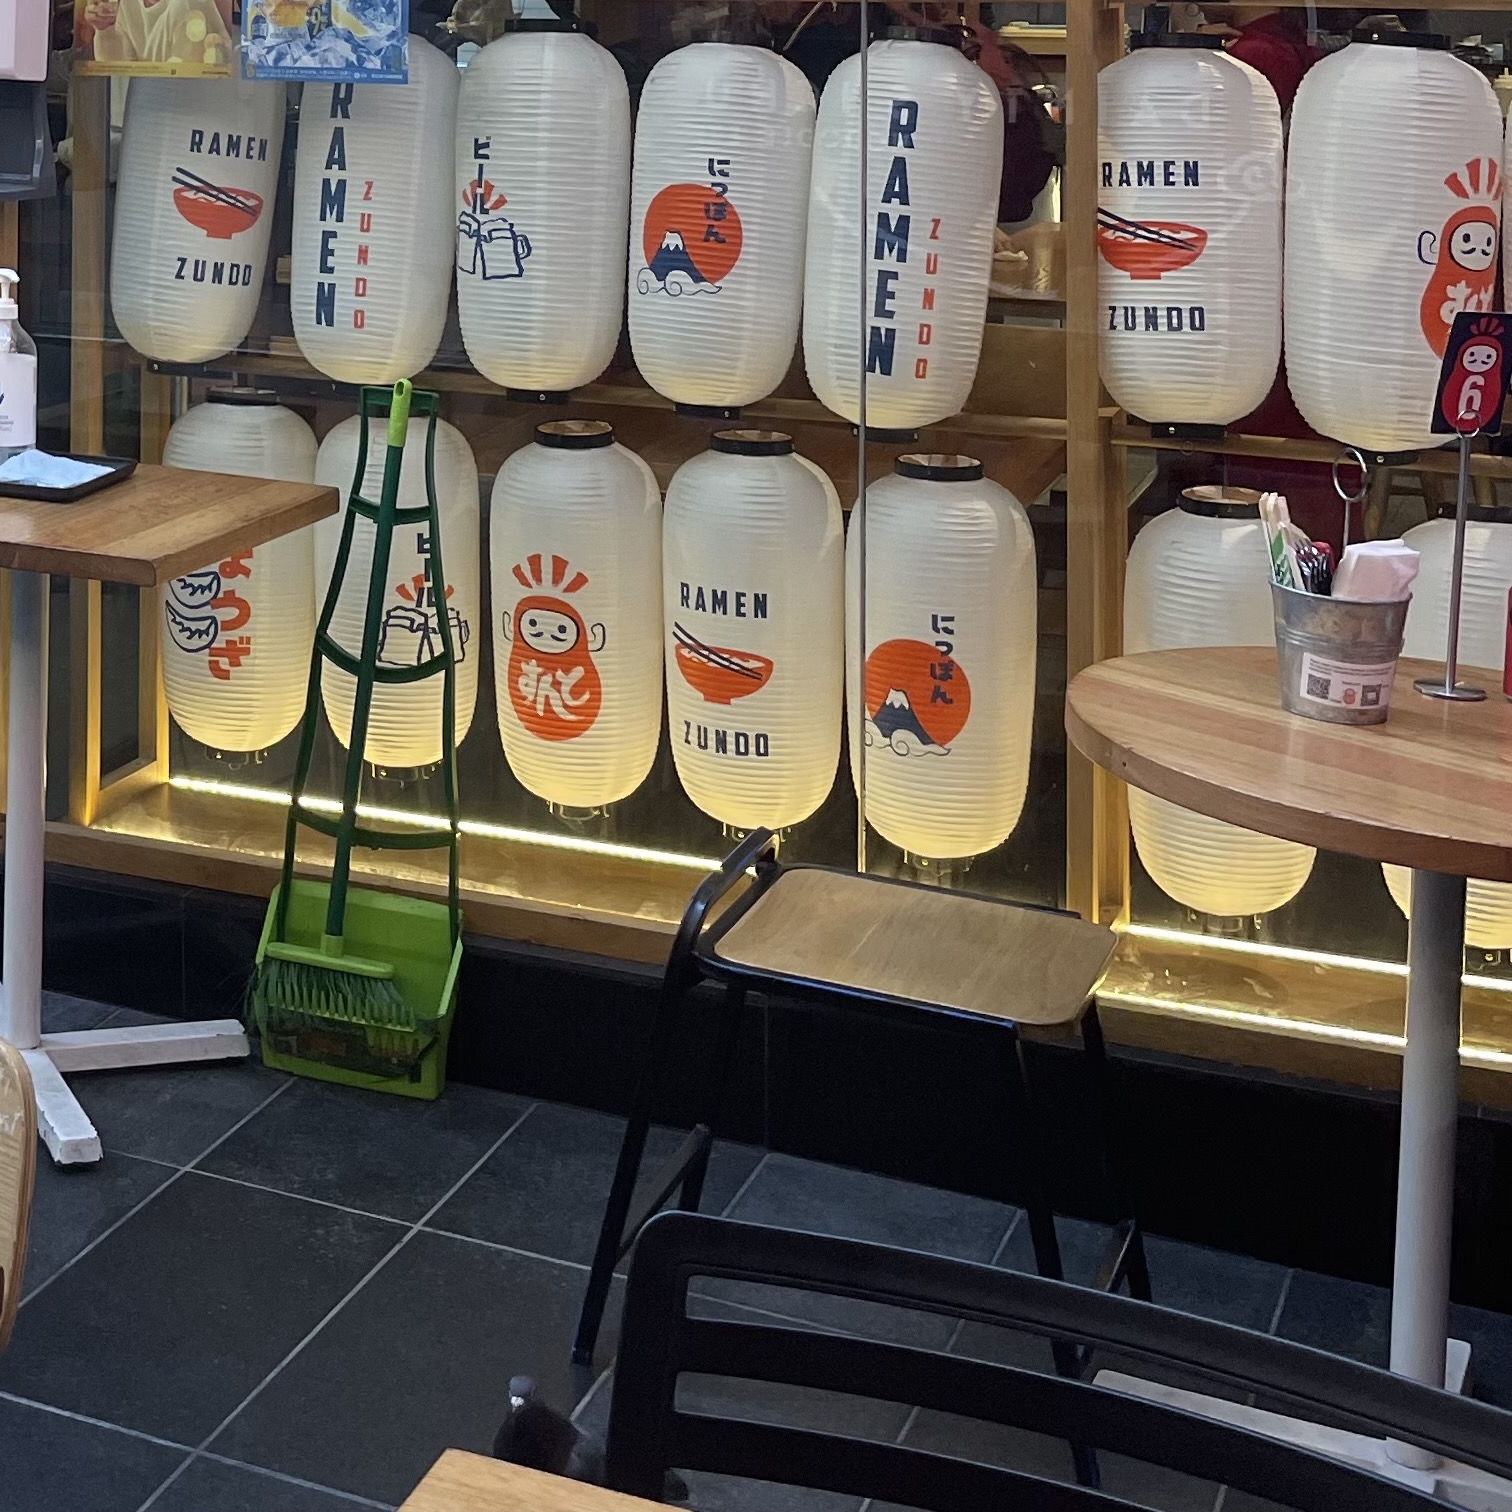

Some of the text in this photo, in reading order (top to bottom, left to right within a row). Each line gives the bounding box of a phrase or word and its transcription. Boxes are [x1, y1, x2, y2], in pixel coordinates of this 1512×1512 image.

[189, 129, 268, 162] RAMEN
[1102, 160, 1200, 188] RAMEN
[315, 82, 354, 328] RAMEN
[353, 180, 374, 329] ZUNDO
[865, 99, 919, 377] RAMEN
[174, 256, 252, 287] ZUNDO
[915, 218, 941, 379] ZUNDO
[1108, 306, 1205, 332] ZUNDO
[1458, 374, 1485, 420] 6
[680, 581, 768, 619] RAMEN
[684, 719, 770, 758] ZUNDO
